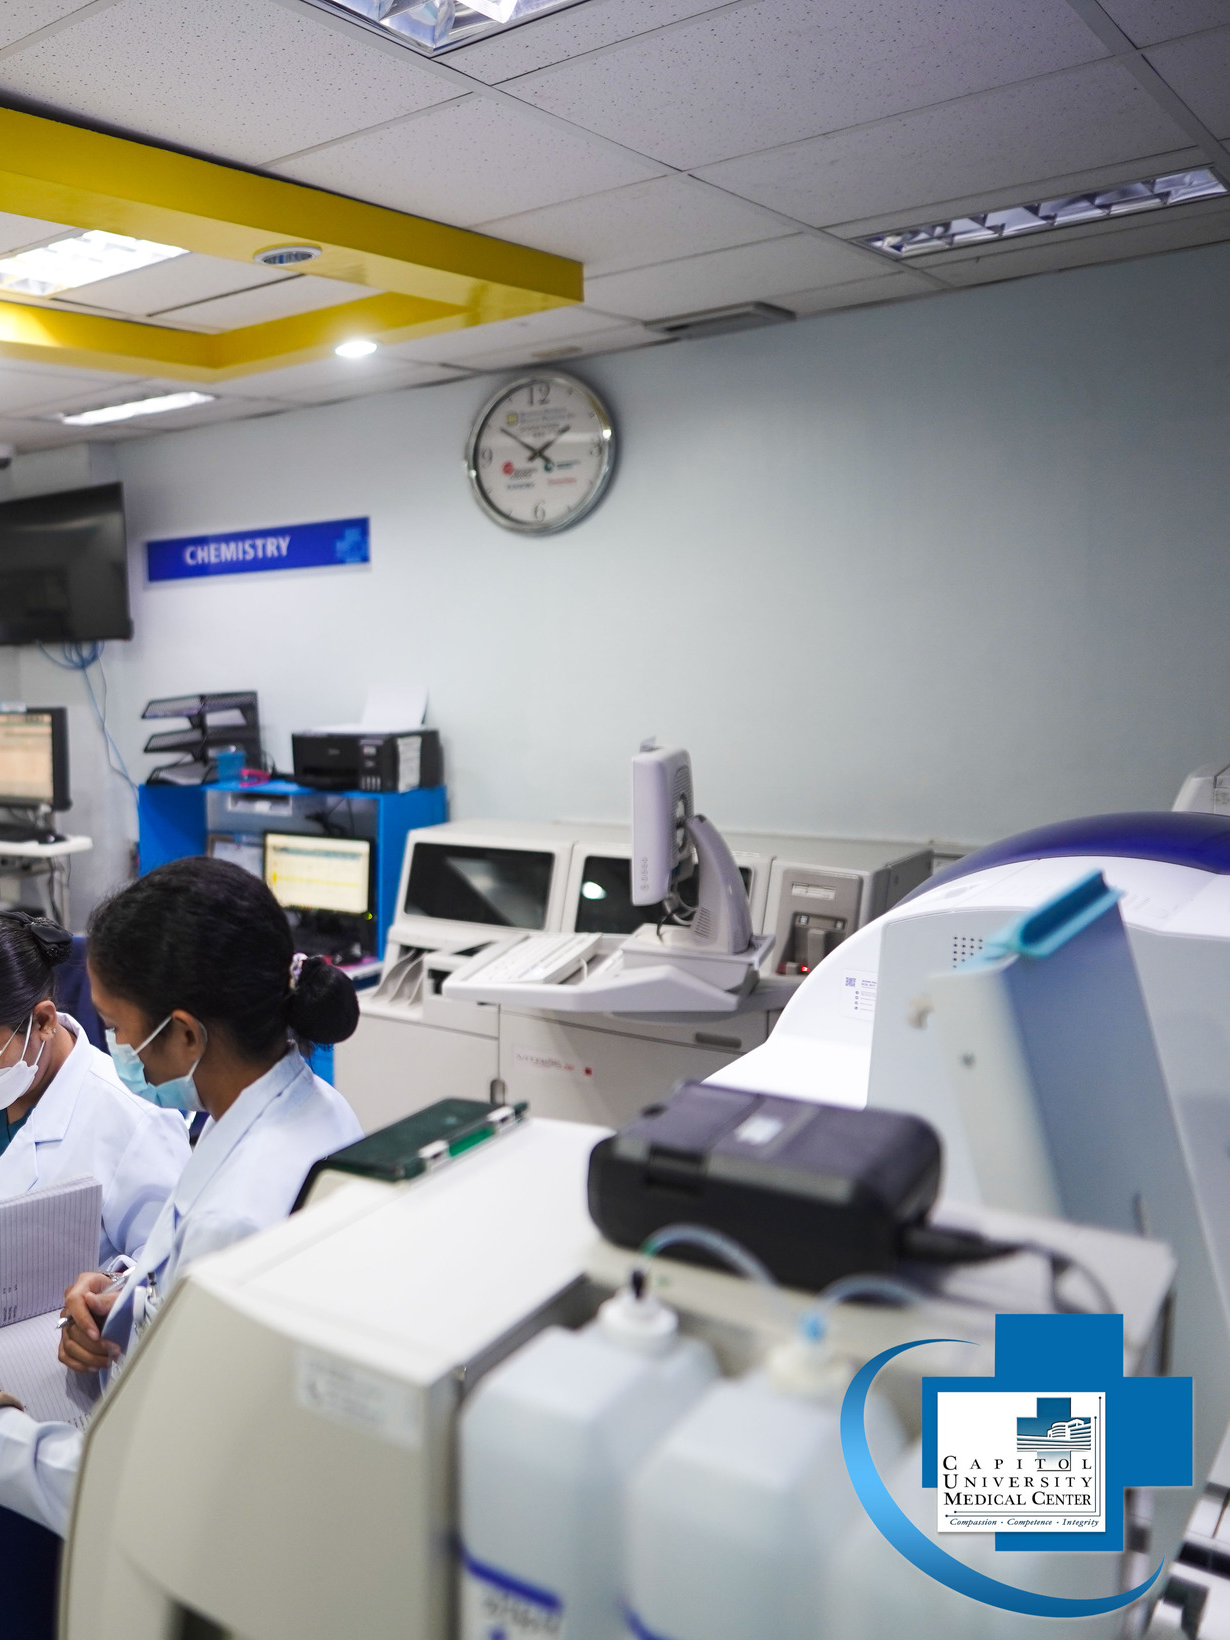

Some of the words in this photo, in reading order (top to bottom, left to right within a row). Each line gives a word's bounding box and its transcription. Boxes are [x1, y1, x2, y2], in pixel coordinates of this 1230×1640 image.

[527, 383, 551, 406] 12
[481, 448, 493, 467] 9
[533, 501, 546, 523] 6
[185, 536, 290, 565] CHEMISTRY
